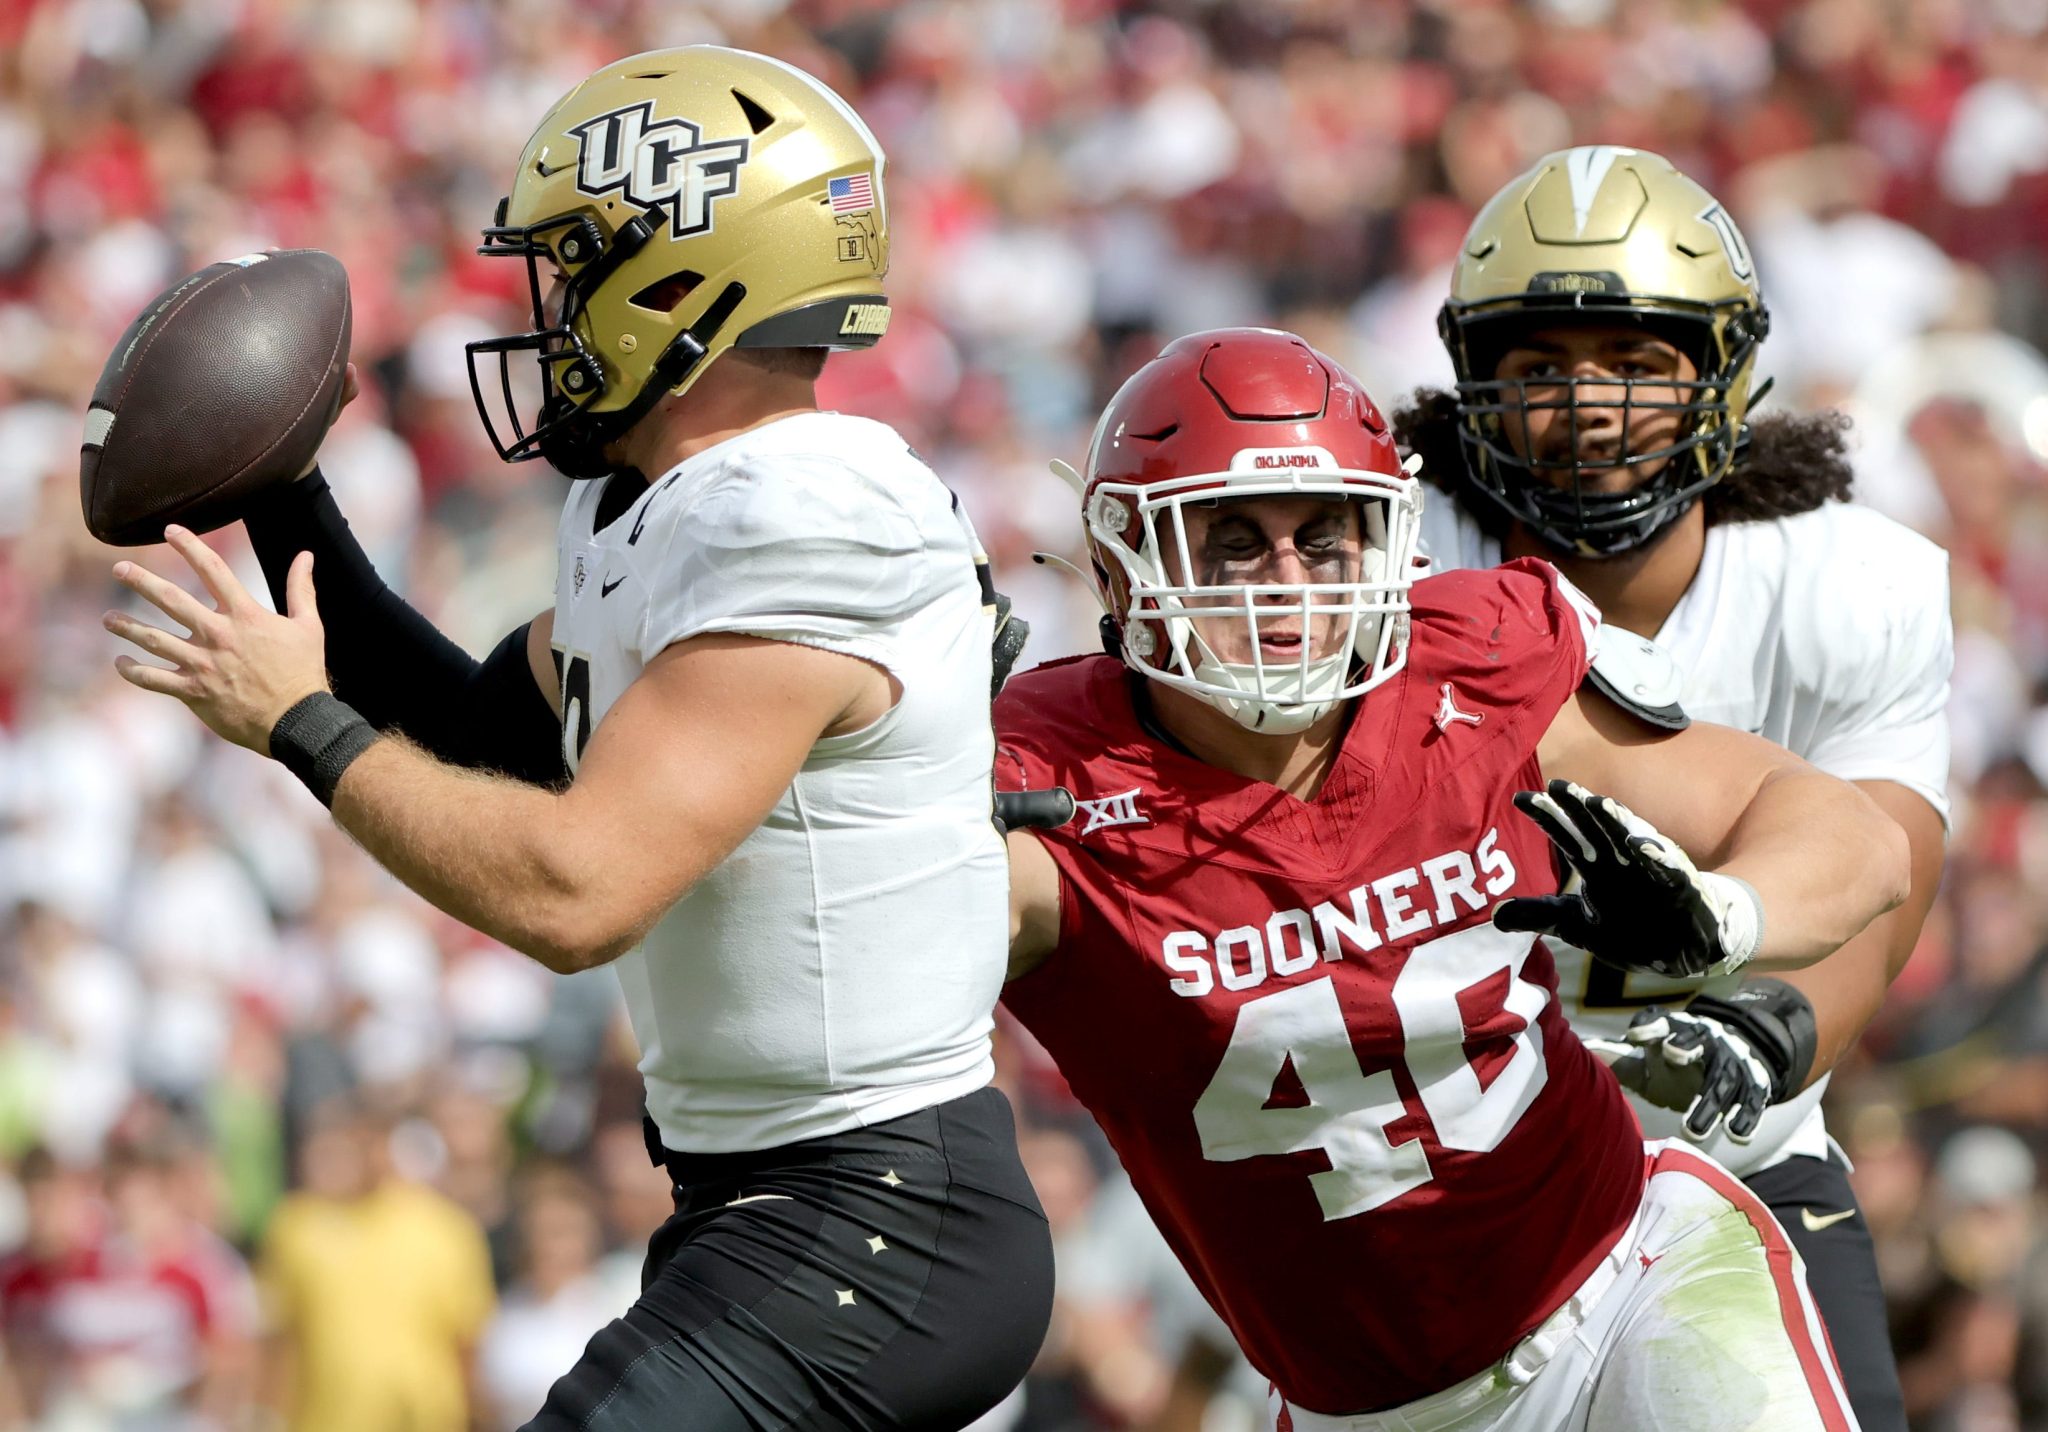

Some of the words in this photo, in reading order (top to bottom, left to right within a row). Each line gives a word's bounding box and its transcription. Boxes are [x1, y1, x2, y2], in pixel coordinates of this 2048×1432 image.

[564, 99, 749, 241] UCF
[846, 239, 858, 257] 10
[156, 276, 202, 313] ELITE
[1254, 454, 1320, 470] OKLAHOMA
[1074, 787, 1150, 837] XII
[1162, 827, 1517, 997] SOONERS
[1192, 921, 1551, 1223] 40
